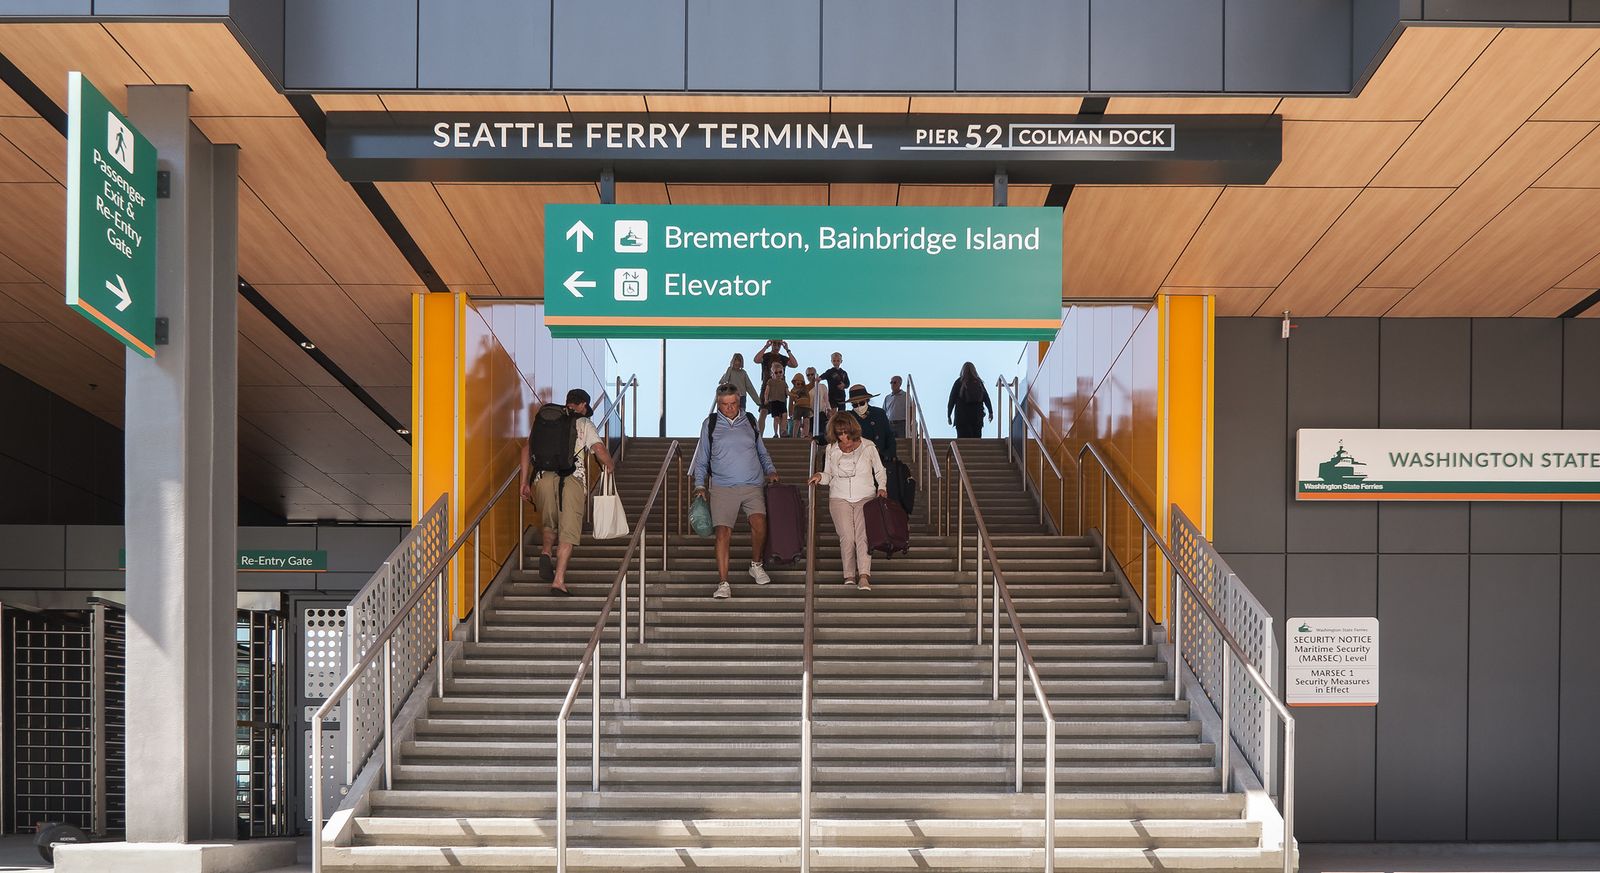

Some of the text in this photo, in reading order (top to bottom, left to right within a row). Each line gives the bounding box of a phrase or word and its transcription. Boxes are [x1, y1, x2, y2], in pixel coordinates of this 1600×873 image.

[433, 122, 873, 149] SEATTLE FERRY TERMINAL
[916, 124, 1003, 149] PIER 52
[1018, 129, 1165, 145] COLMAN DOCK
[93, 148, 146, 207] Passenger
[104, 180, 135, 221] Exit &
[96, 195, 142, 247] Re-Entry
[107, 228, 133, 259] Gate
[665, 225, 1040, 255] Bremerton, Bainbridge Island
[665, 272, 772, 296] Elevator
[1388, 452, 1600, 468] WASHINGTON STATE
[1304, 483, 1342, 491] Washington
[241, 555, 313, 568] Re-Entry Gate
[1294, 635, 1372, 644] SECURITY NOTICE
[1294, 645, 1371, 654] Maritime Security
[1298, 654, 1367, 664] (MARSEC) Level
[1311, 669, 1346, 677] MARSEC
[1295, 677, 1370, 687] Security Measures
[1315, 686, 1350, 694] in Effect
